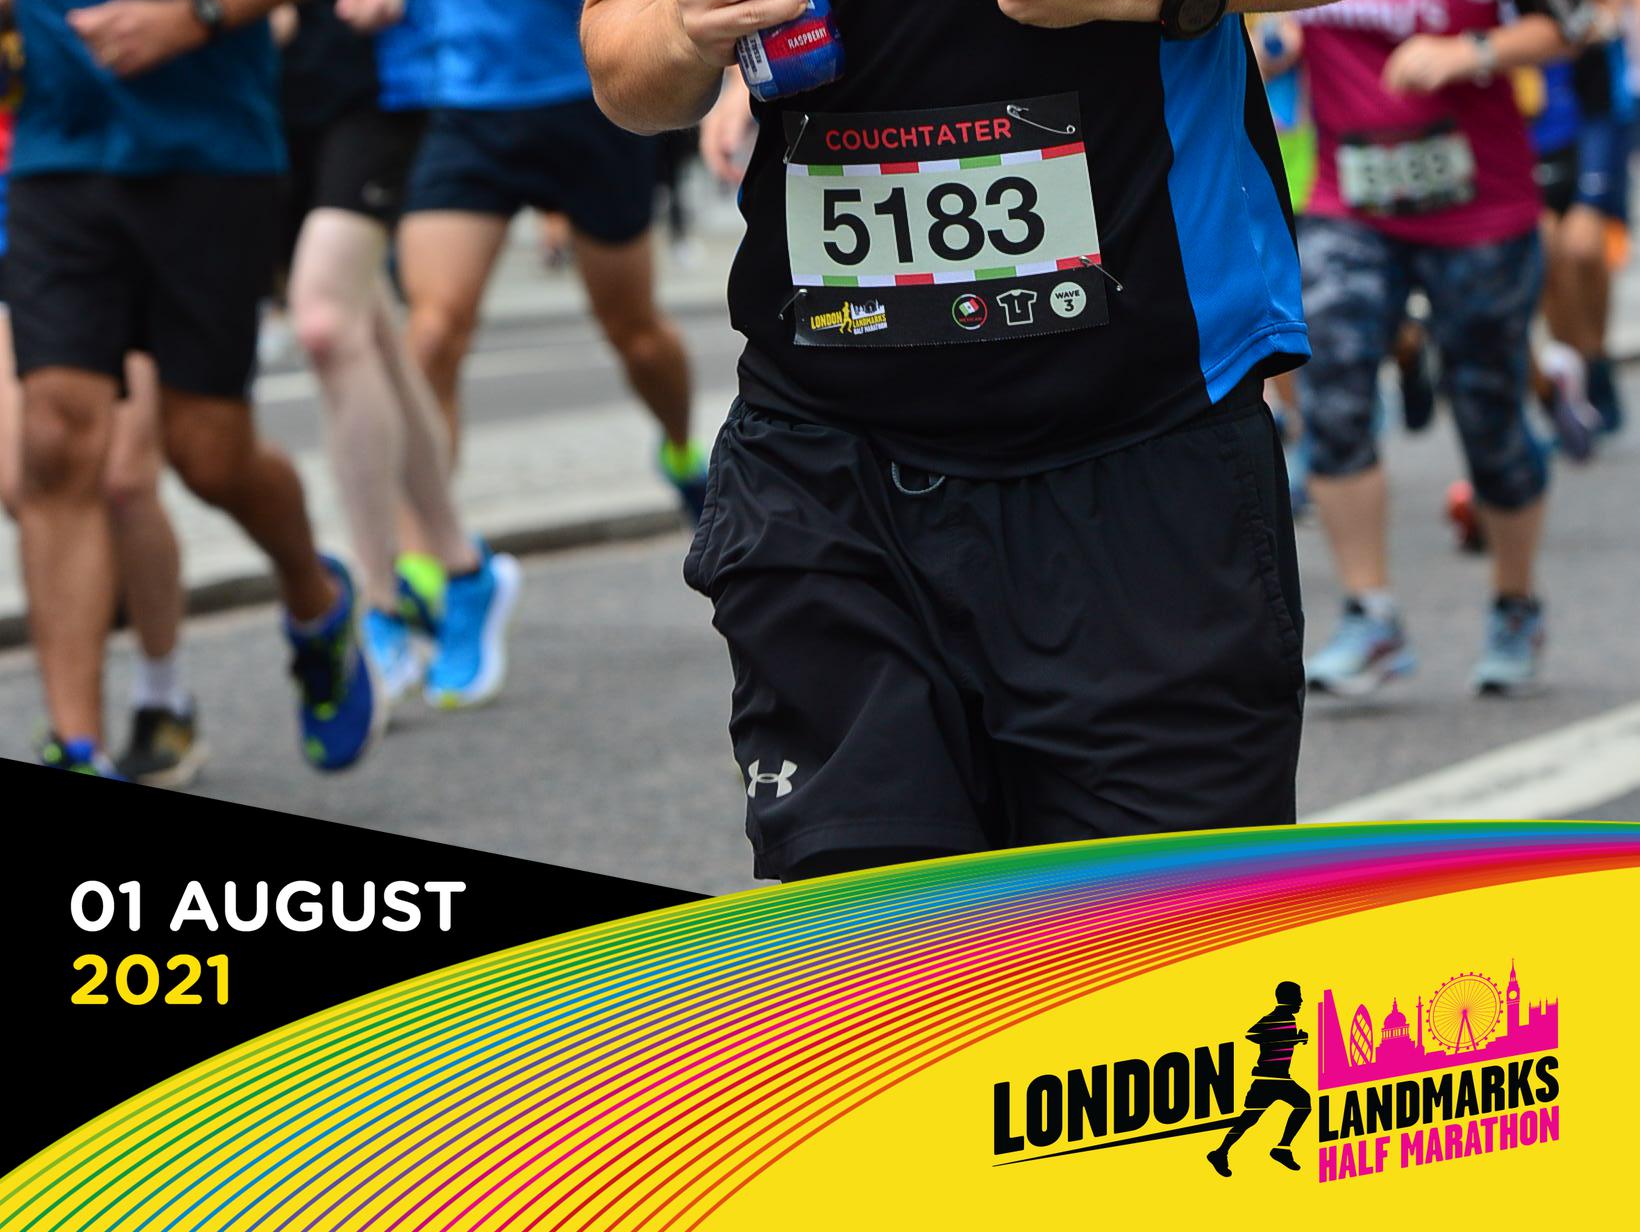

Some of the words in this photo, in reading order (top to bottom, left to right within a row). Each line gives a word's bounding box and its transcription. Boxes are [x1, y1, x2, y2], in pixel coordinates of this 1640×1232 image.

[787, 28, 827, 49] RASPBERRY
[825, 118, 1013, 151] COUCHTATER
[823, 176, 1045, 266] 5183
[1055, 289, 1080, 300] WAVE
[1013, 298, 1022, 314] L
[1063, 299, 1076, 313] 3
[811, 311, 842, 329] LONDON
[853, 314, 886, 327] LANDMARKS
